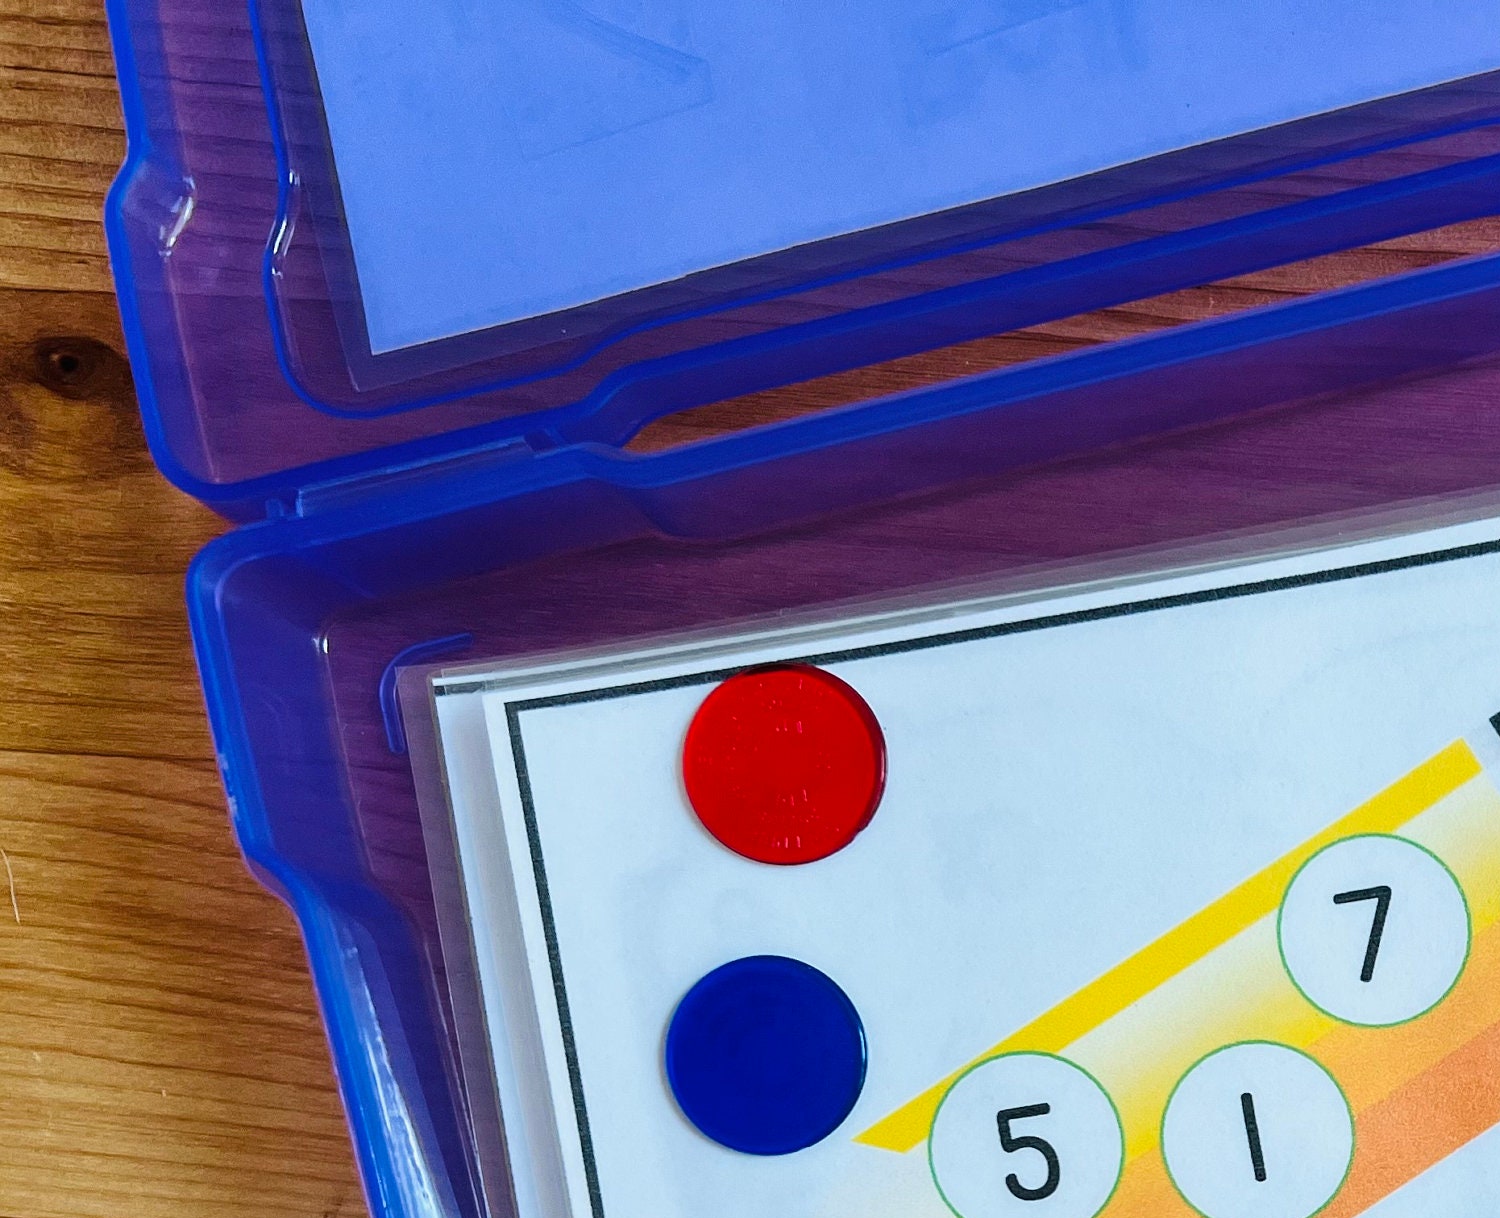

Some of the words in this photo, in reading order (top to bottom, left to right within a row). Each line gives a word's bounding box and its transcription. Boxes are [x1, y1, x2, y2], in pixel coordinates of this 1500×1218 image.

[1332, 885, 1392, 983] 7
[995, 1101, 1061, 1201] 5
[1239, 1091, 1267, 1182] 1
